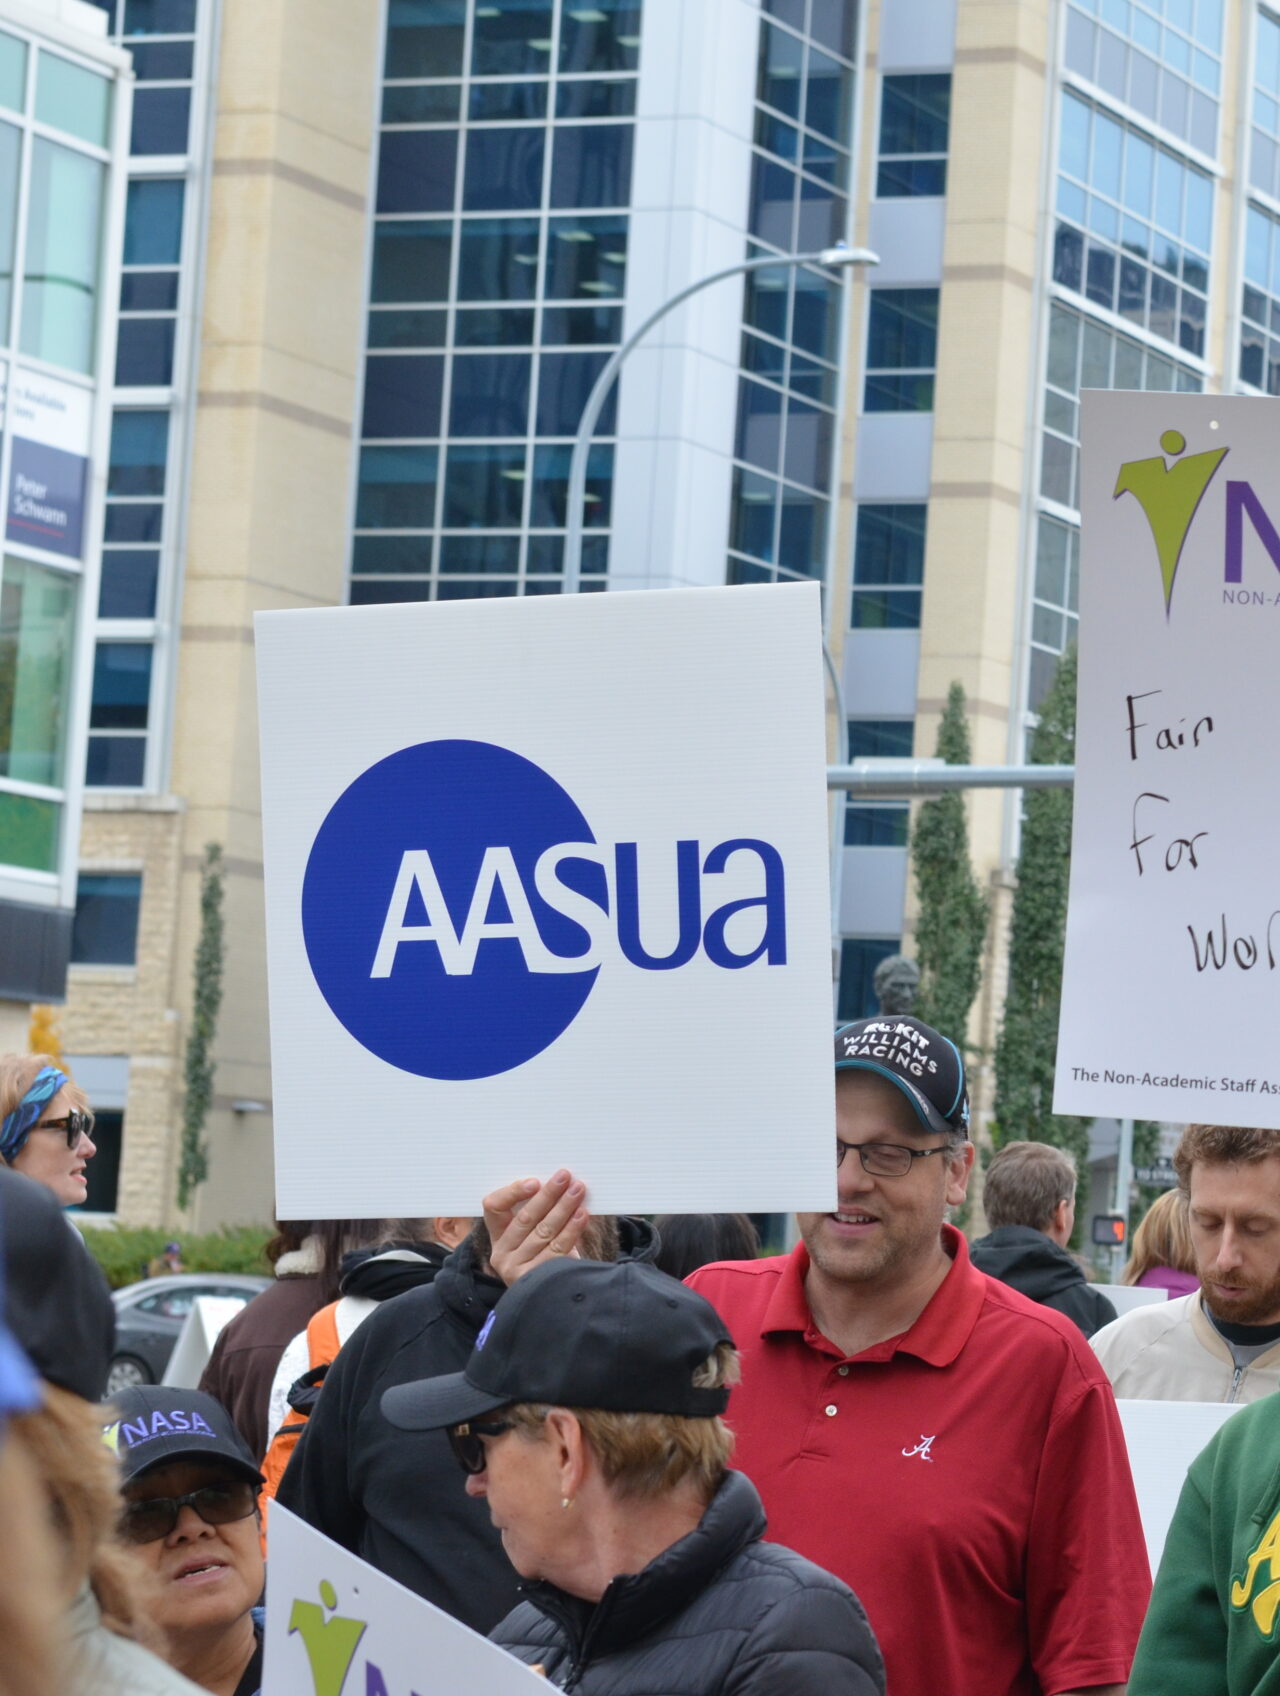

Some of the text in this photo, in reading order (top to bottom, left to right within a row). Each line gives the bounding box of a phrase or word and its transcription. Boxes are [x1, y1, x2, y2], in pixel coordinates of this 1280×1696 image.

[15, 472, 48, 499] Peter
[13, 494, 68, 528] Schwann
[1126, 690, 1214, 761] Fair
[843, 1033, 938, 1074] WILLIAMS
[845, 1044, 924, 1077] RACING
[1071, 1067, 1100, 1082] The
[1104, 1069, 1216, 1091] Non-Academic
[1221, 1077, 1257, 1093] Staff
[121, 1410, 213, 1445] NASA
